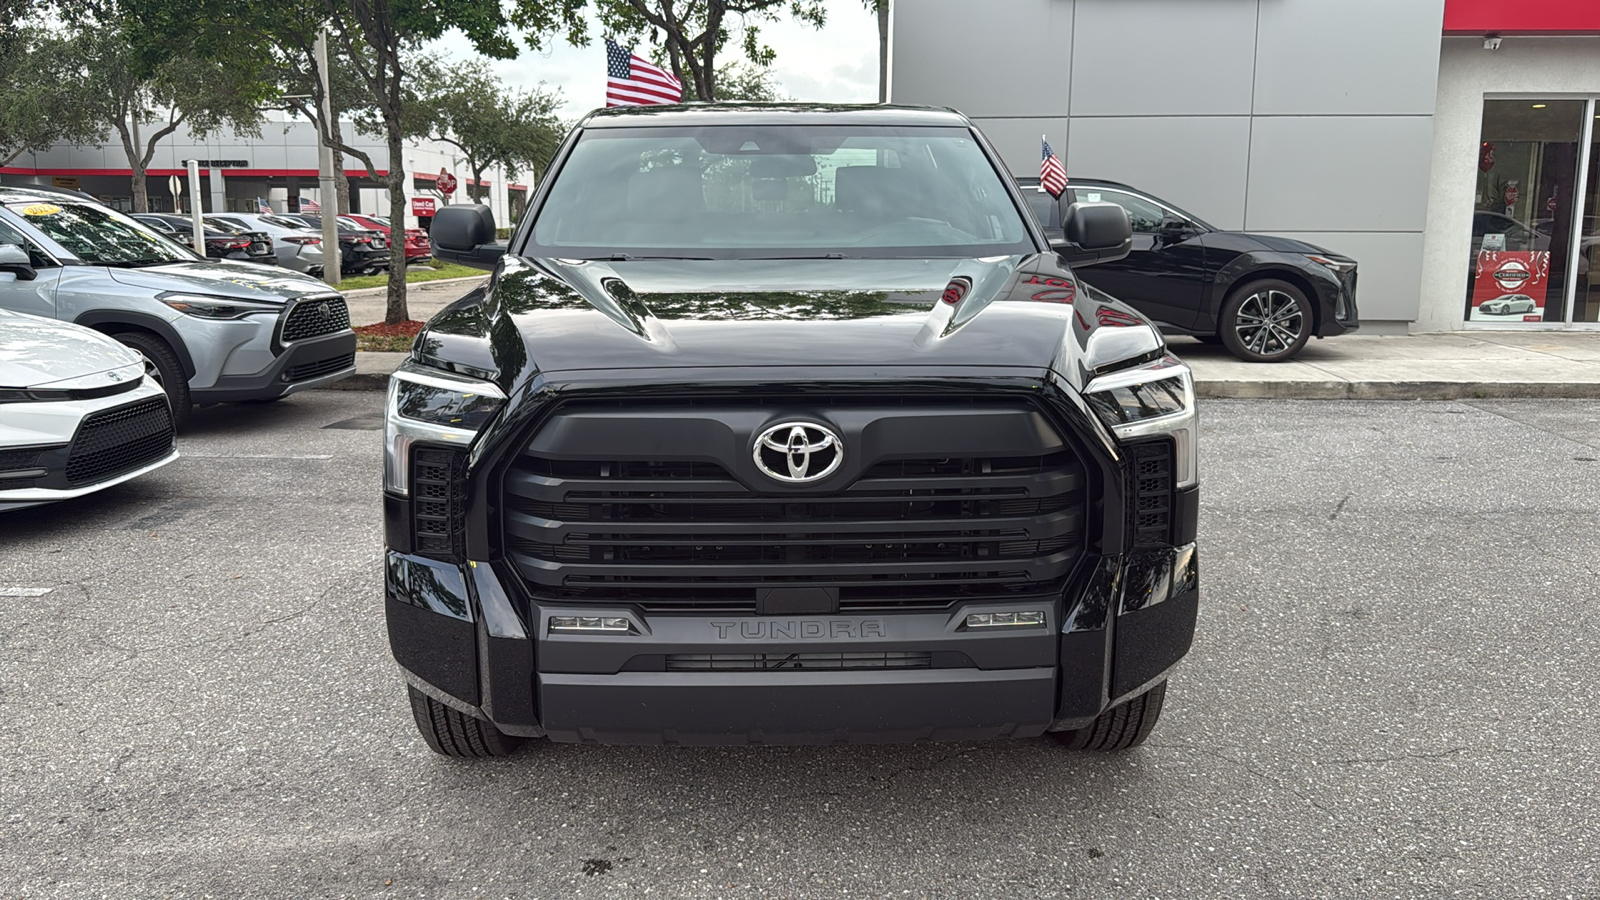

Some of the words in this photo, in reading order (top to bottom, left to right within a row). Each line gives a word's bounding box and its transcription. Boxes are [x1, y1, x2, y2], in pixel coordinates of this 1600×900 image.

[181, 160, 209, 168] SICE
[210, 160, 248, 168] RECEPTION
[438, 179, 456, 189] SOP
[710, 619, 886, 639] TUNDRA
